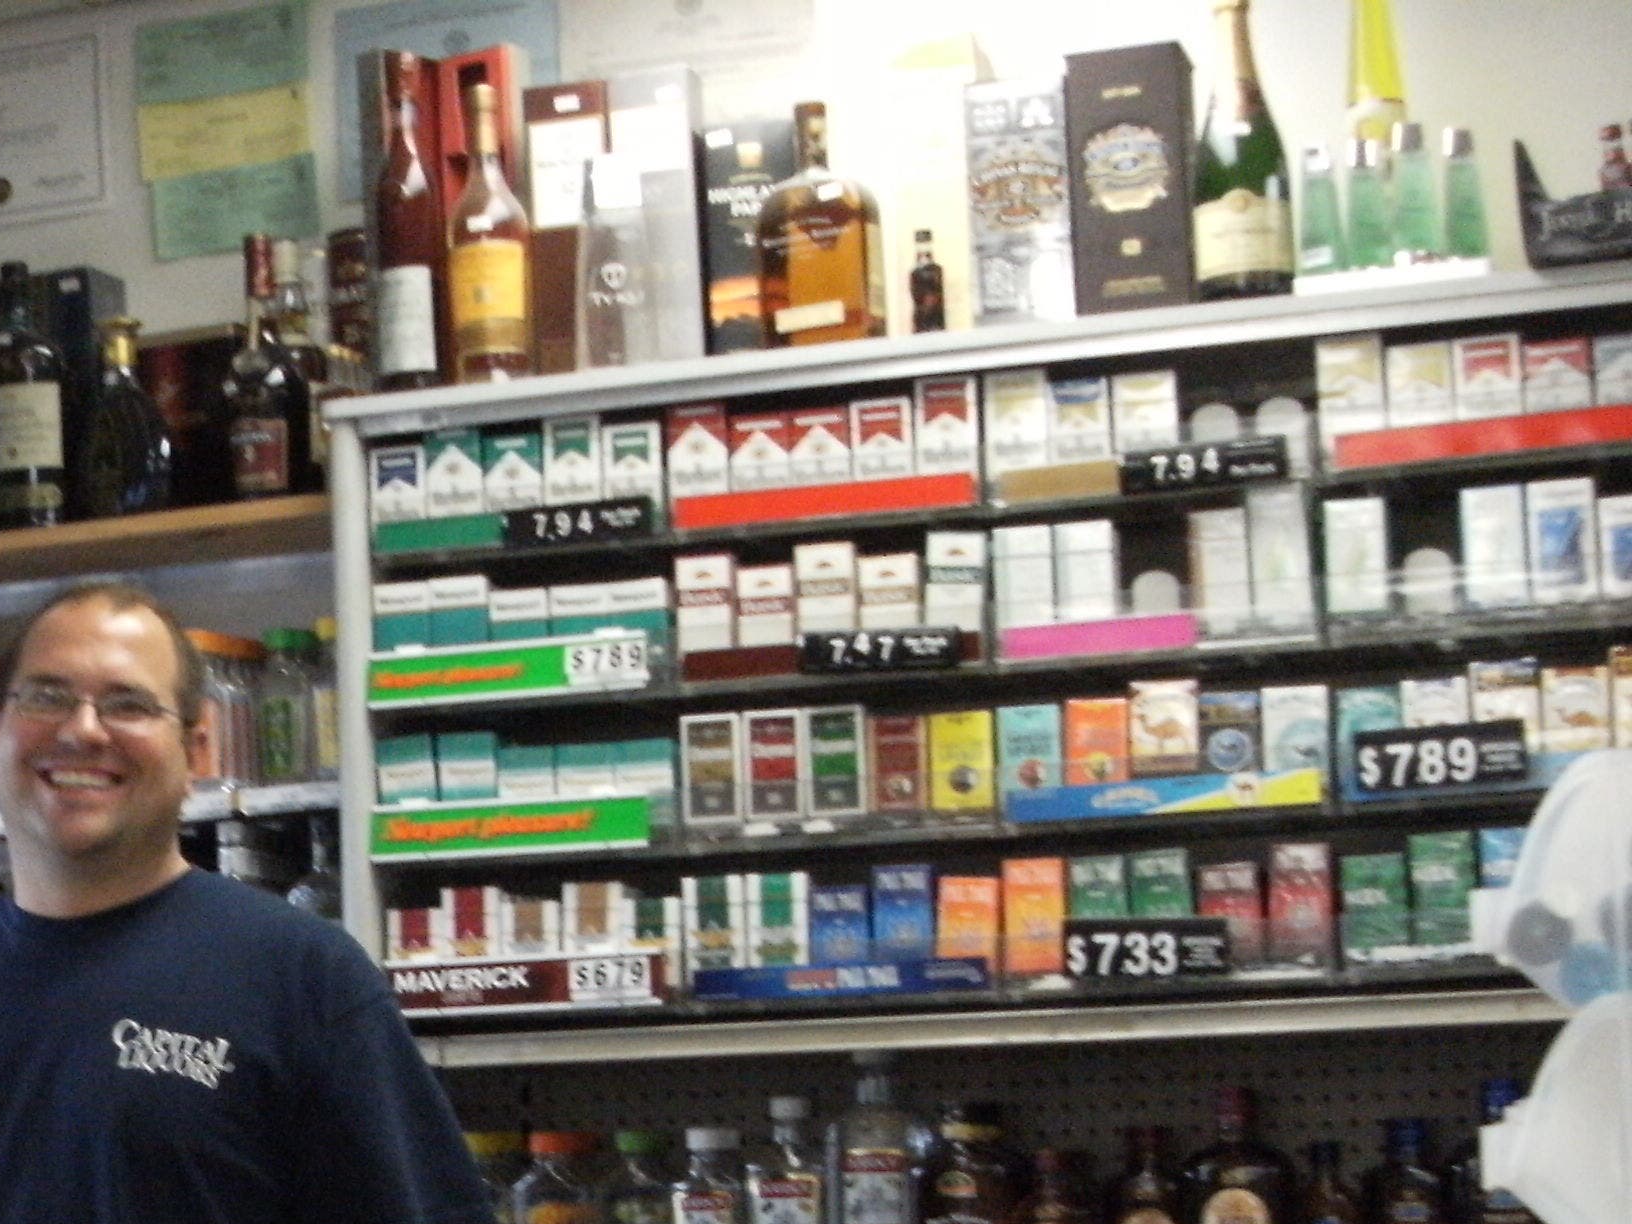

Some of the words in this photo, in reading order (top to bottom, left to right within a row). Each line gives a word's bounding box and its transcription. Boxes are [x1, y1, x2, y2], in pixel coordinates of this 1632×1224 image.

[1358, 737, 1478, 789] $789
[1066, 931, 1179, 976] $733
[393, 965, 531, 993] MAVERICK
